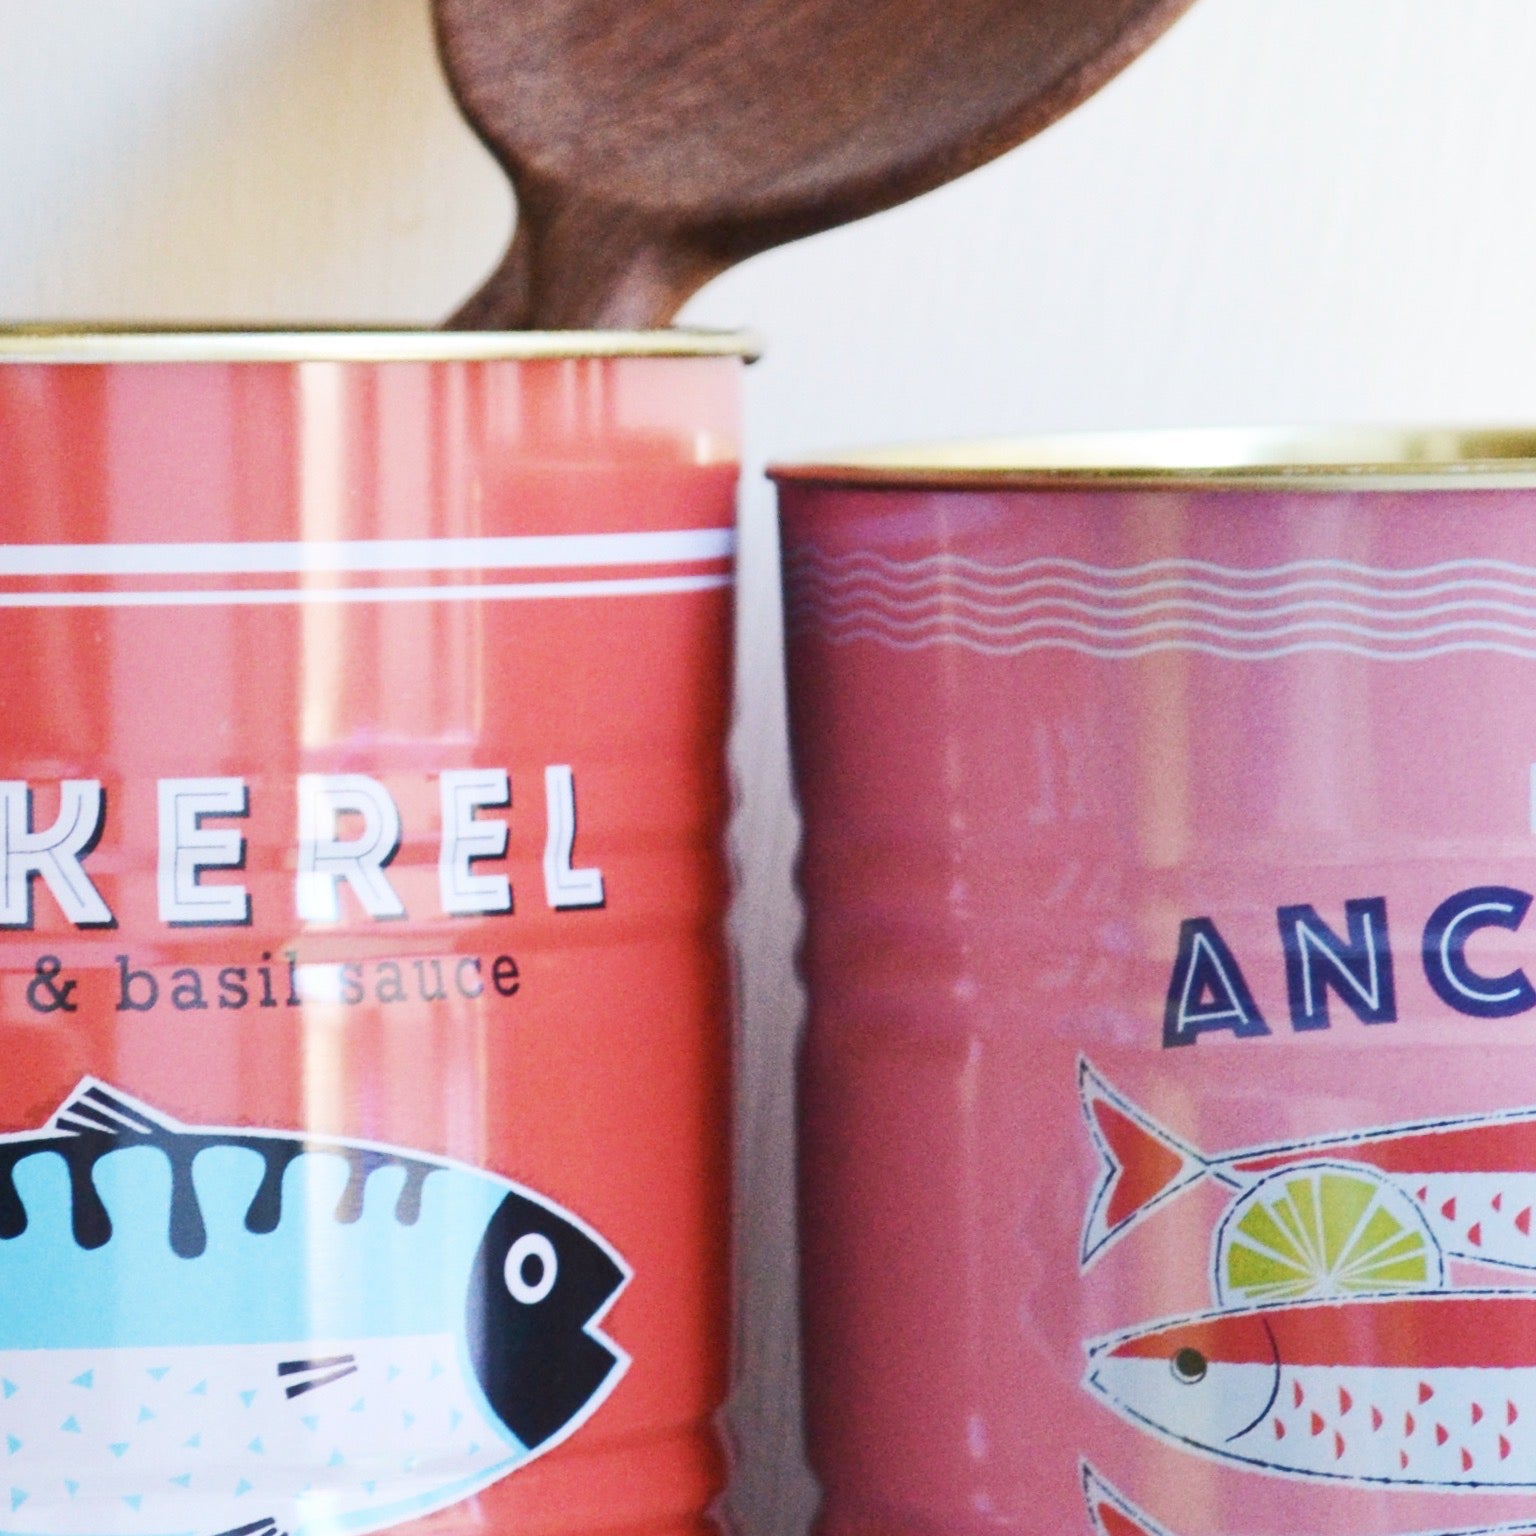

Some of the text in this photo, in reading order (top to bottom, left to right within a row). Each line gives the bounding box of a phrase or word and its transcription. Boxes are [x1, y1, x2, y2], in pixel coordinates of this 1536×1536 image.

[26, 955, 77, 1014] &
[116, 950, 302, 1012] basil
[336, 953, 520, 1005] sauce
